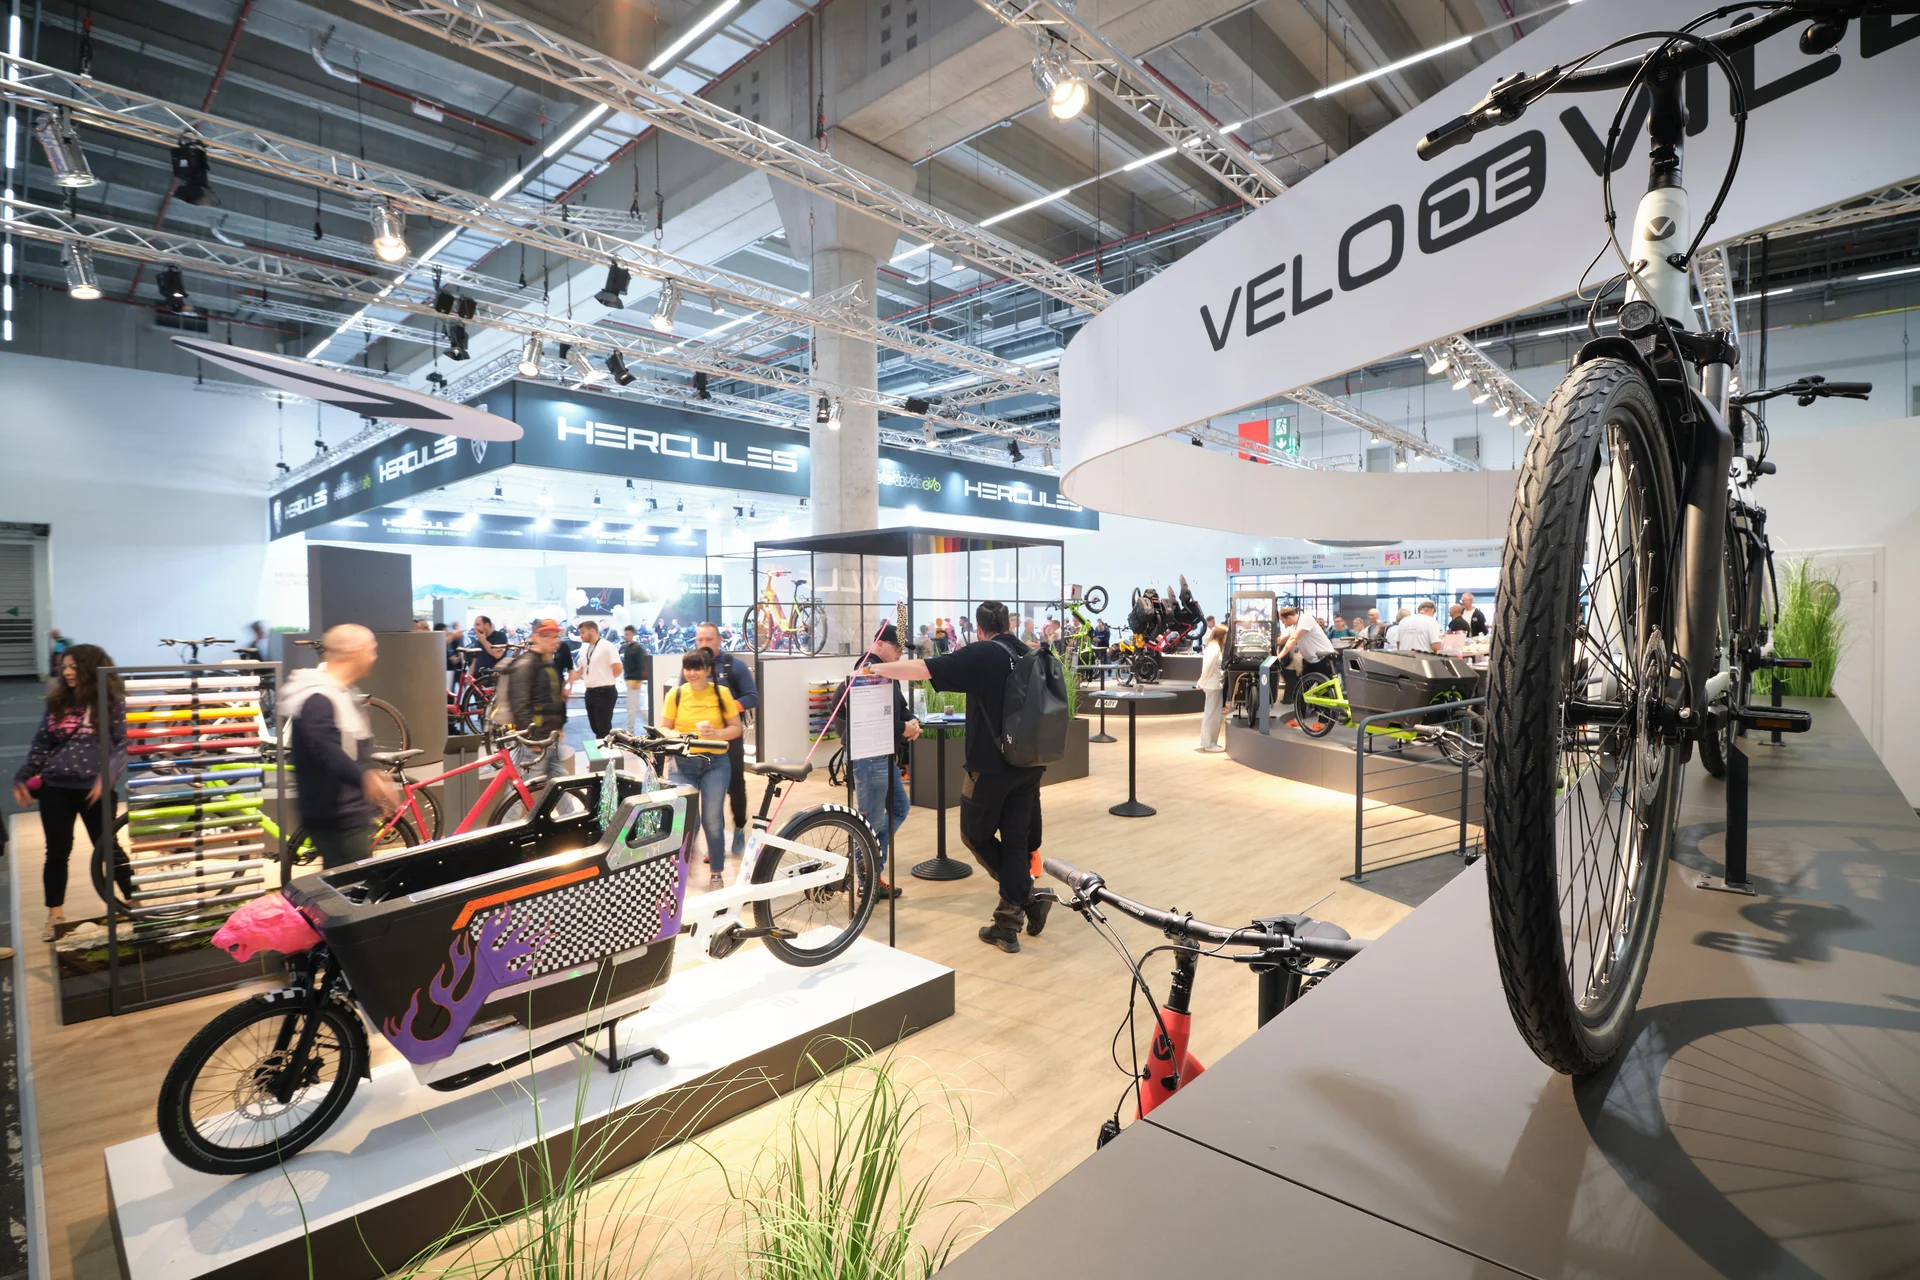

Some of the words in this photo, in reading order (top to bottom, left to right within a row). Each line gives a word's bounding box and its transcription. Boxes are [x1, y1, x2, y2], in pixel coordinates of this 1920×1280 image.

[1199, 203, 1405, 352] VELO
[1427, 144, 1533, 241] DE
[379, 434, 457, 483] HERCULES
[558, 416, 798, 473] HERCULES
[1403, 550, 1421, 560] 12.1
